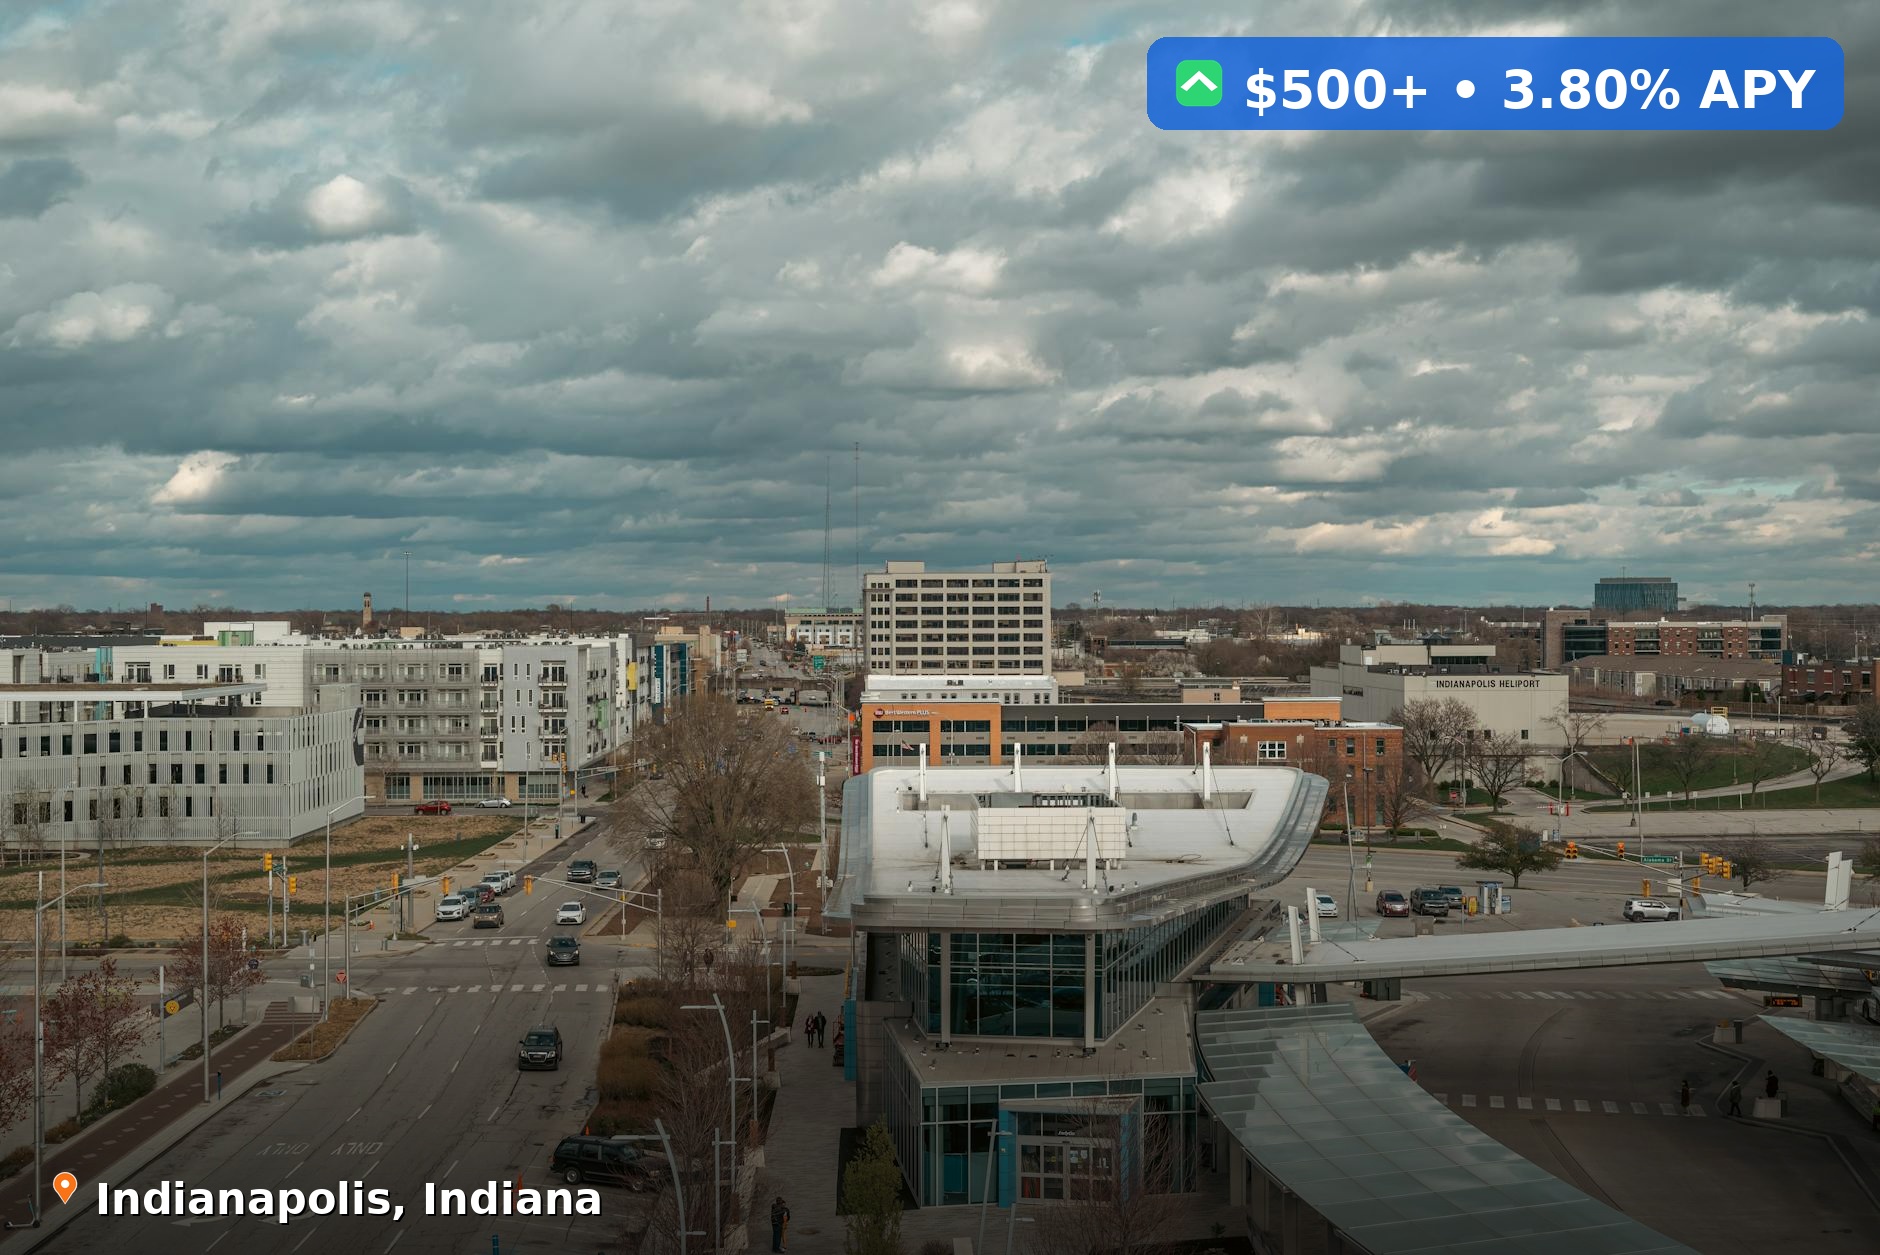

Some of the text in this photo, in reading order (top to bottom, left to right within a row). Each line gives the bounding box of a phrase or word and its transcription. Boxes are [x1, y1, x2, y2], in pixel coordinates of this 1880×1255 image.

[1436, 680, 1540, 688] INDIANAPOLIS HELIPORT
[330, 1142, 384, 1156] ONLY
